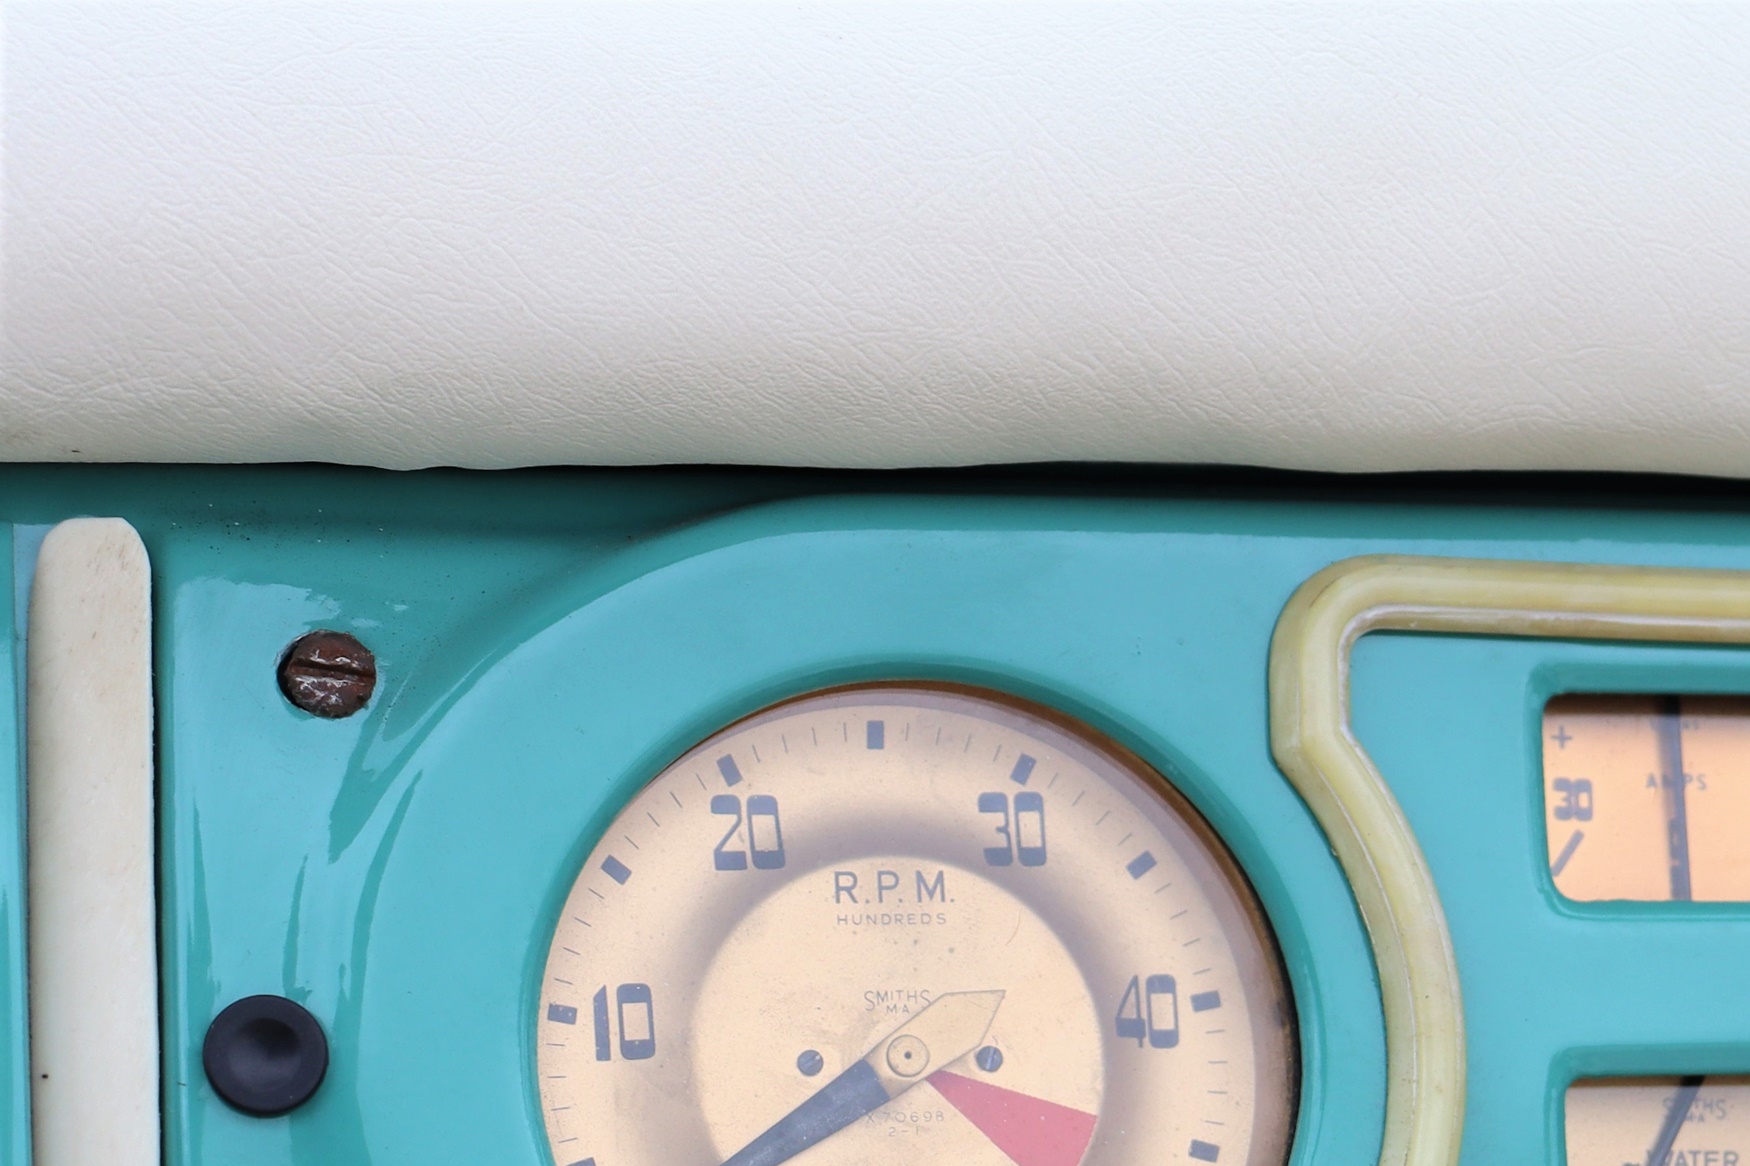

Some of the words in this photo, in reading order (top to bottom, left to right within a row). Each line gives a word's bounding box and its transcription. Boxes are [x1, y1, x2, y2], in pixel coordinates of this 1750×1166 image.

[710, 794, 786, 871] 20
[978, 792, 1047, 867] 30
[1552, 777, 1593, 821] 30
[837, 913, 946, 926] HUNDREDS
[593, 982, 656, 1061] 10
[864, 989, 930, 1012] SMITHS
[1115, 973, 1179, 1049] 40
